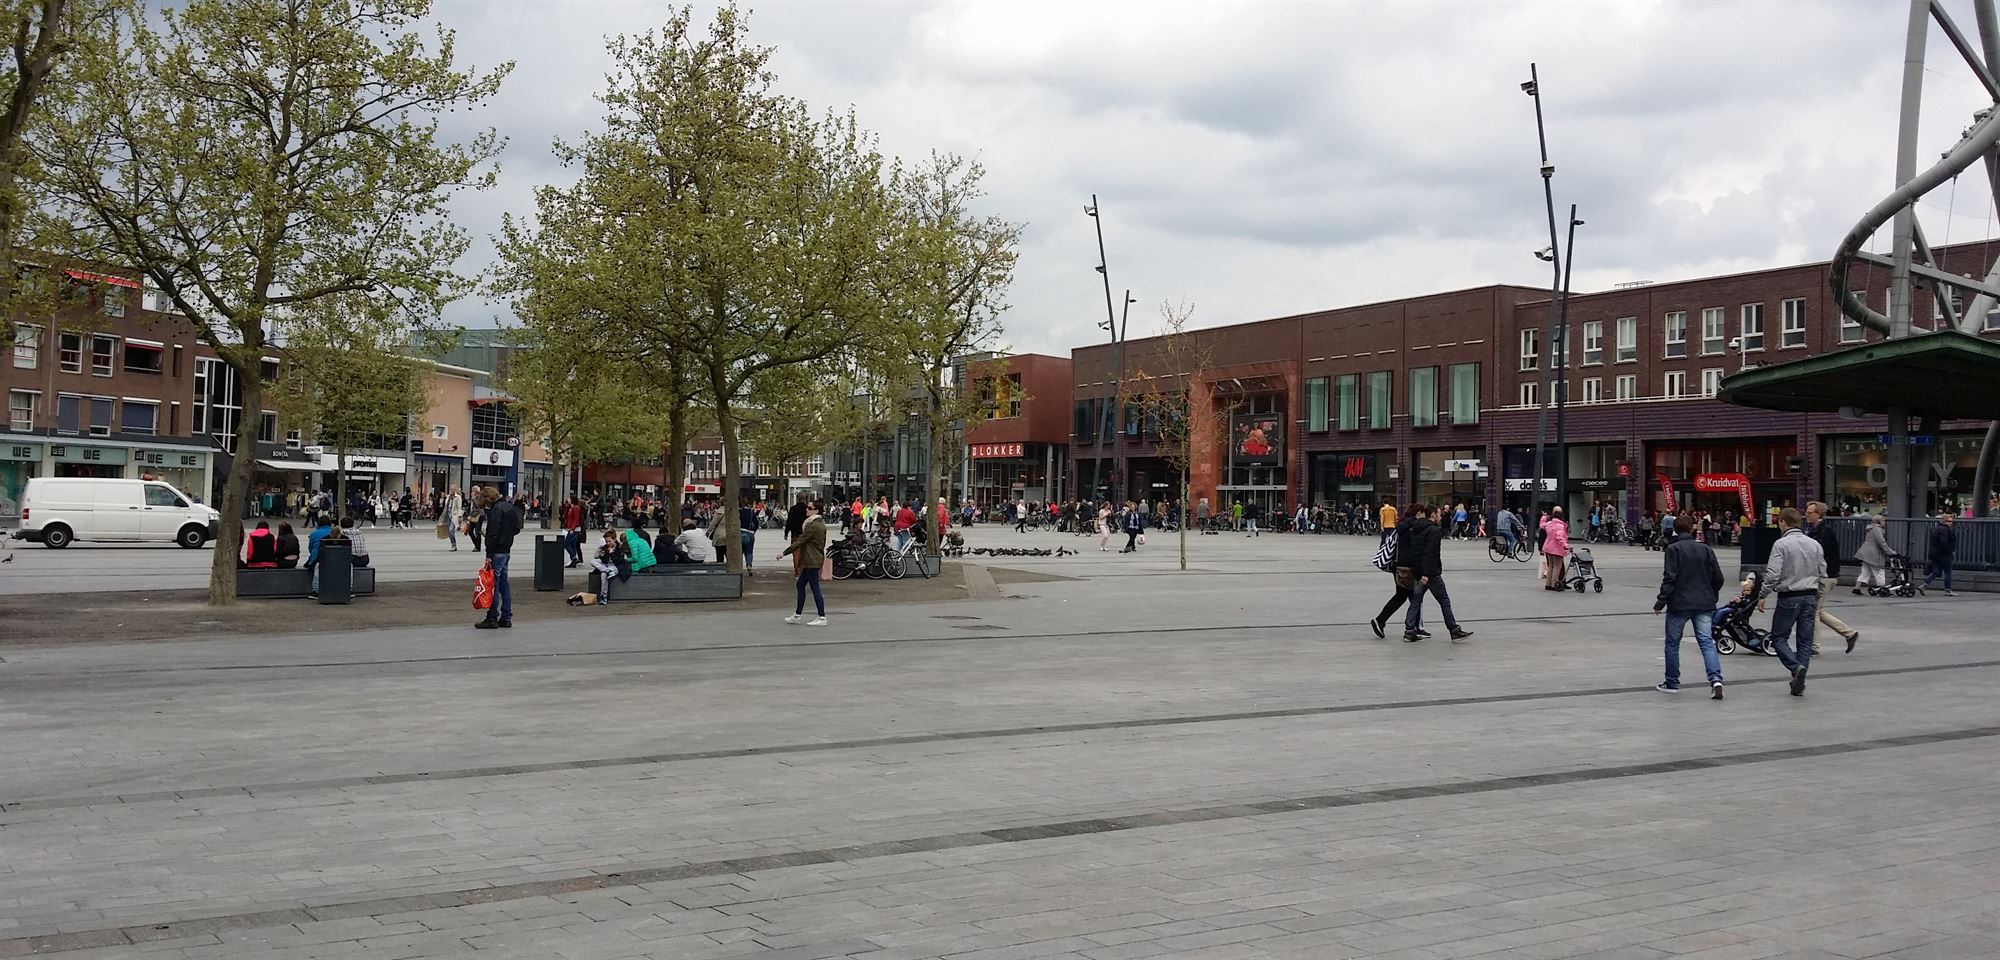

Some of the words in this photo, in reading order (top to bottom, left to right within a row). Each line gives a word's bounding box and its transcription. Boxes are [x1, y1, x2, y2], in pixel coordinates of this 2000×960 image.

[12, 446, 31, 457] WE
[83, 449, 101, 460] WE
[272, 450, 289, 458] BONITA
[972, 445, 1021, 456] BLOKKER
[147, 453, 164, 464] WE
[180, 455, 197, 465] WE
[1344, 457, 1365, 479] H&M
[1707, 477, 1739, 487] Kruidvat
